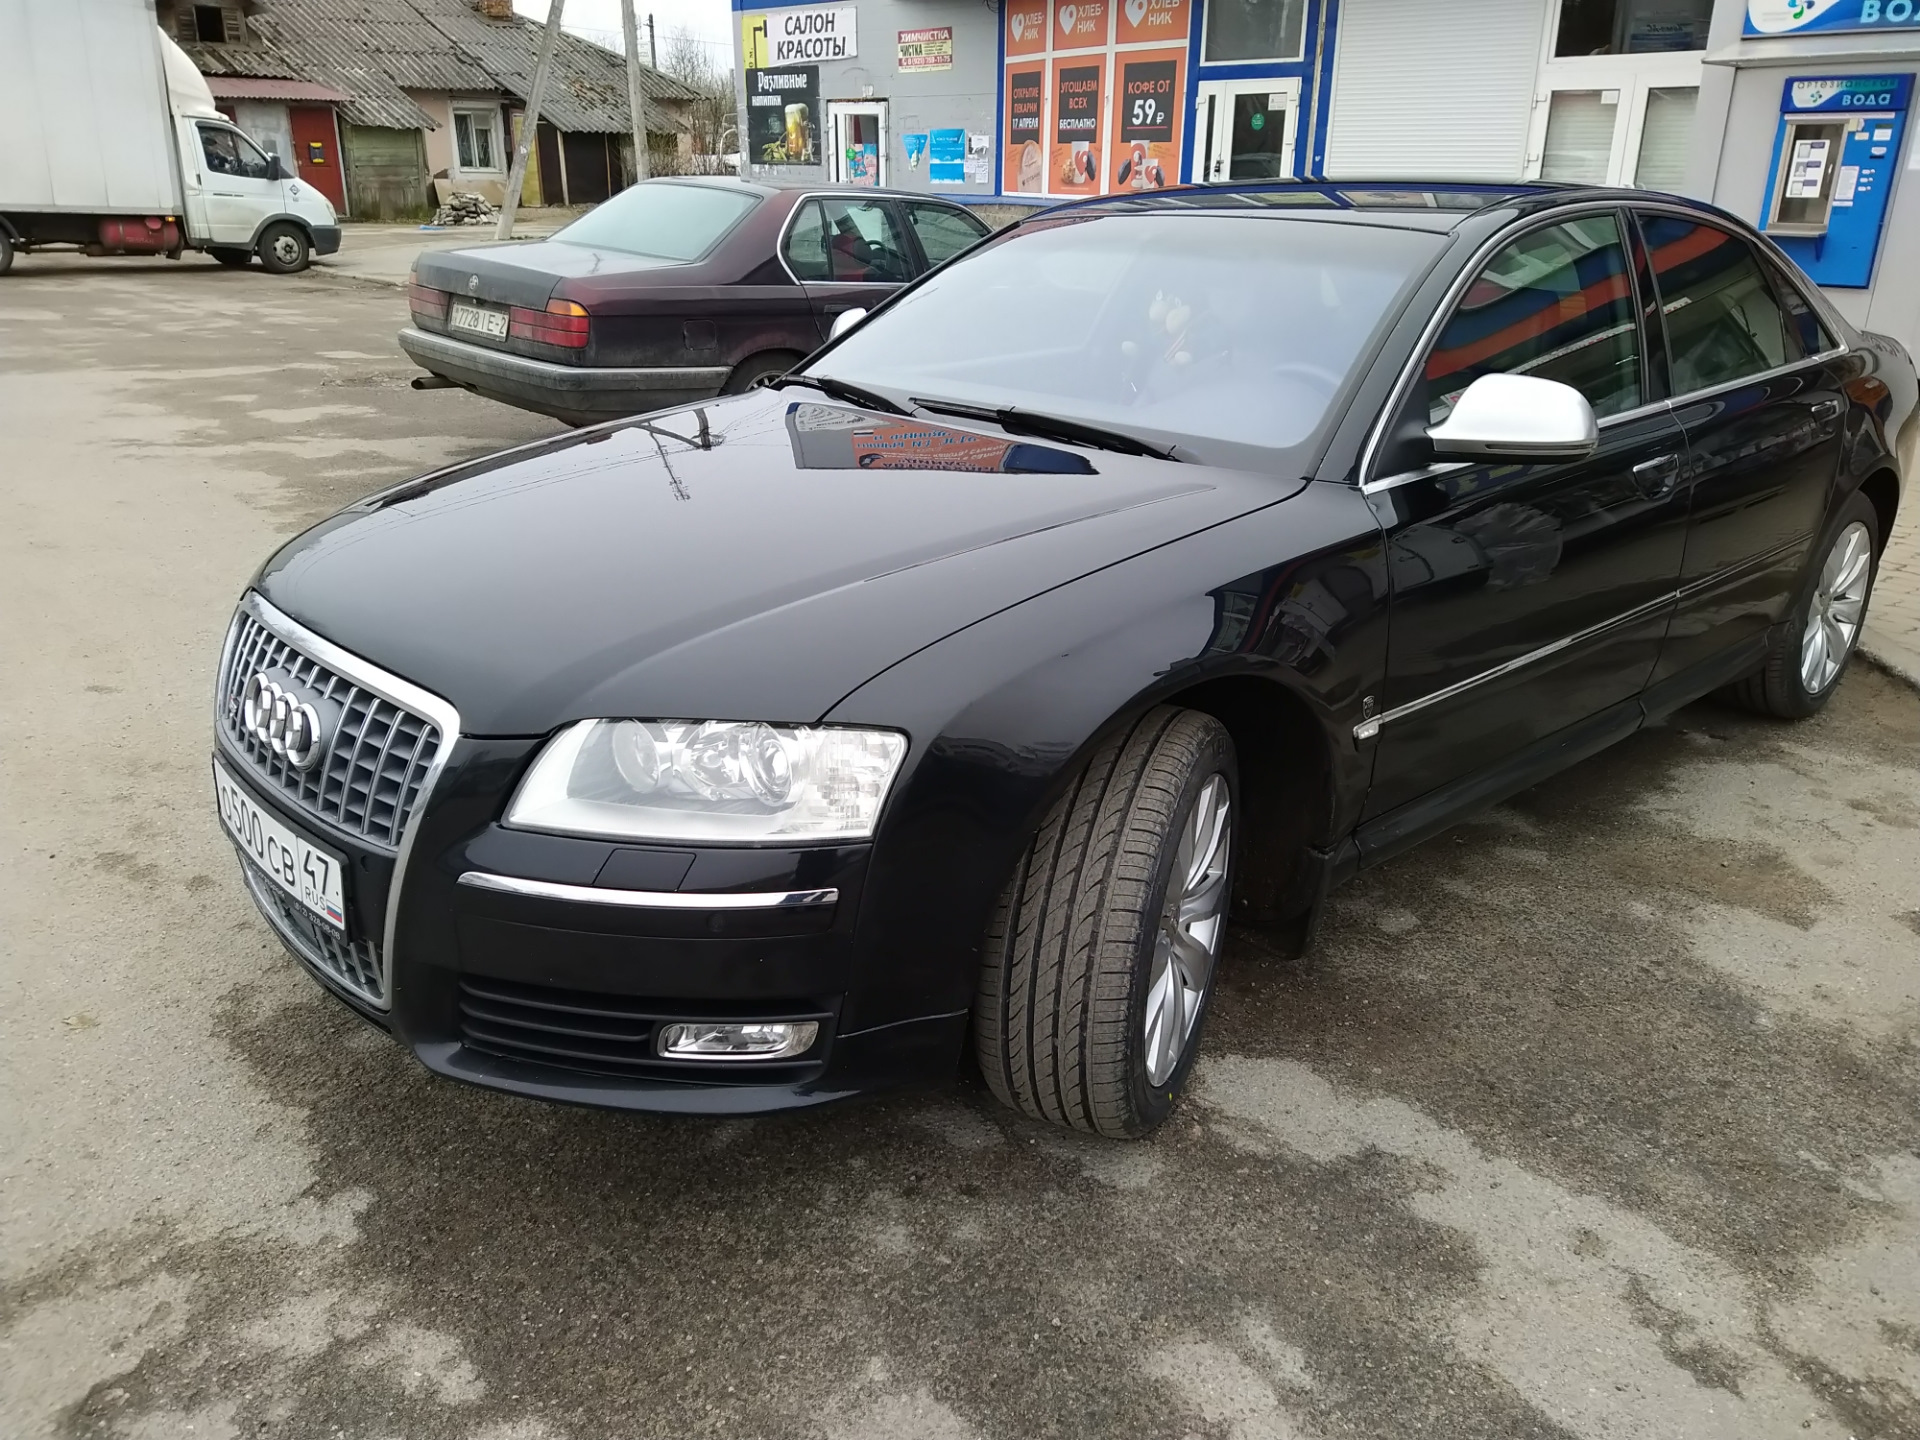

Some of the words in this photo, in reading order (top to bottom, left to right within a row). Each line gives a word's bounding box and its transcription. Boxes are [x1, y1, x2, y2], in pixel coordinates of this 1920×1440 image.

[1148, 12, 1172, 25] НИК
[1860, 0, 1920, 23] ВО
[784, 12, 835, 36] САЛОН
[1077, 20, 1096, 34] НИК
[900, 30, 950, 42] ХИМЧИСТКА
[1024, 28, 1038, 40] НИК
[778, 36, 846, 60] КРАСОТЫ
[900, 44, 922, 56] ЧИСТКА
[757, 72, 808, 92] Разливные
[1060, 80, 1097, 94] УГОЩАЕМ
[1128, 81, 1154, 94] КОФЕ
[1157, 80, 1170, 92] ОТ
[1013, 87, 1039, 98] ОТКРЫТИЕ
[1014, 102, 1038, 113] ПЕКАРНИ
[1069, 97, 1088, 109] ВСЕХ
[1012, 118, 1018, 128] 17
[1019, 118, 1038, 128] АПРЕЛЯ
[1060, 118, 1096, 129] БЕСПЛАТНО
[458, 308, 480, 328] 7728
[303, 849, 330, 896] 47
[305, 886, 326, 911] RUS
